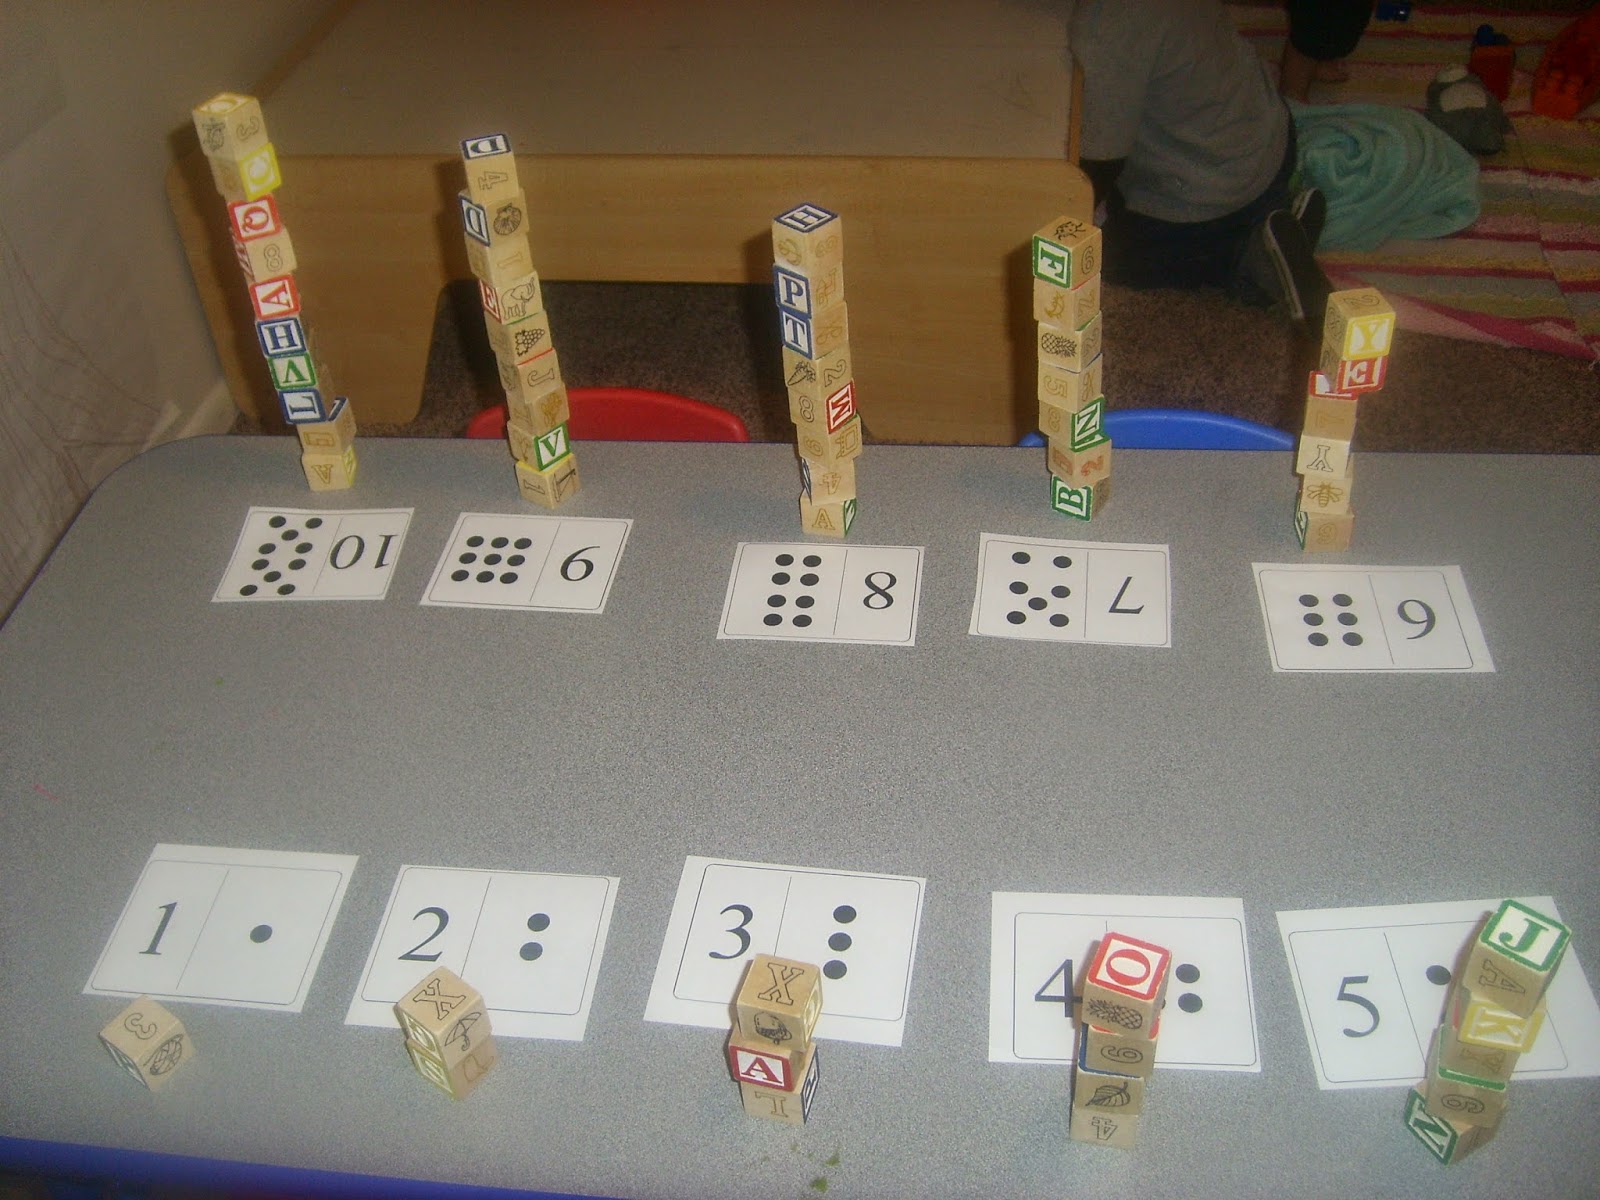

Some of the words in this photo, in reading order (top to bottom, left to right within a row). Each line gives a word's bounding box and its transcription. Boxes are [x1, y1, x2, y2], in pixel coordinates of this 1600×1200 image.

[477, 171, 509, 191] 4
[242, 206, 269, 232] Q
[785, 208, 826, 228] H
[263, 243, 283, 273] 8
[261, 281, 291, 308] A
[782, 276, 804, 307] P
[265, 323, 298, 350] H
[785, 315, 806, 348] T
[1043, 375, 1069, 399] 5
[799, 395, 815, 423] 8
[540, 429, 562, 457] V
[1306, 444, 1334, 473] Y
[1057, 485, 1084, 512] B
[811, 508, 836, 531] A
[329, 534, 398, 570] 10
[863, 571, 897, 610] 8
[1108, 576, 1145, 615] 7
[138, 901, 178, 956] 1
[397, 906, 450, 962] 2
[708, 903, 754, 960] 3
[1498, 917, 1550, 953] J
[1105, 948, 1151, 987] O
[1478, 958, 1526, 995] A
[412, 977, 467, 1021] X
[767, 962, 805, 1006] X
[1034, 958, 1084, 1018] 4
[1336, 975, 1381, 1038] 5
[123, 1012, 158, 1041] 3
[741, 1056, 784, 1085] A
[1091, 1115, 1118, 1141] 4
